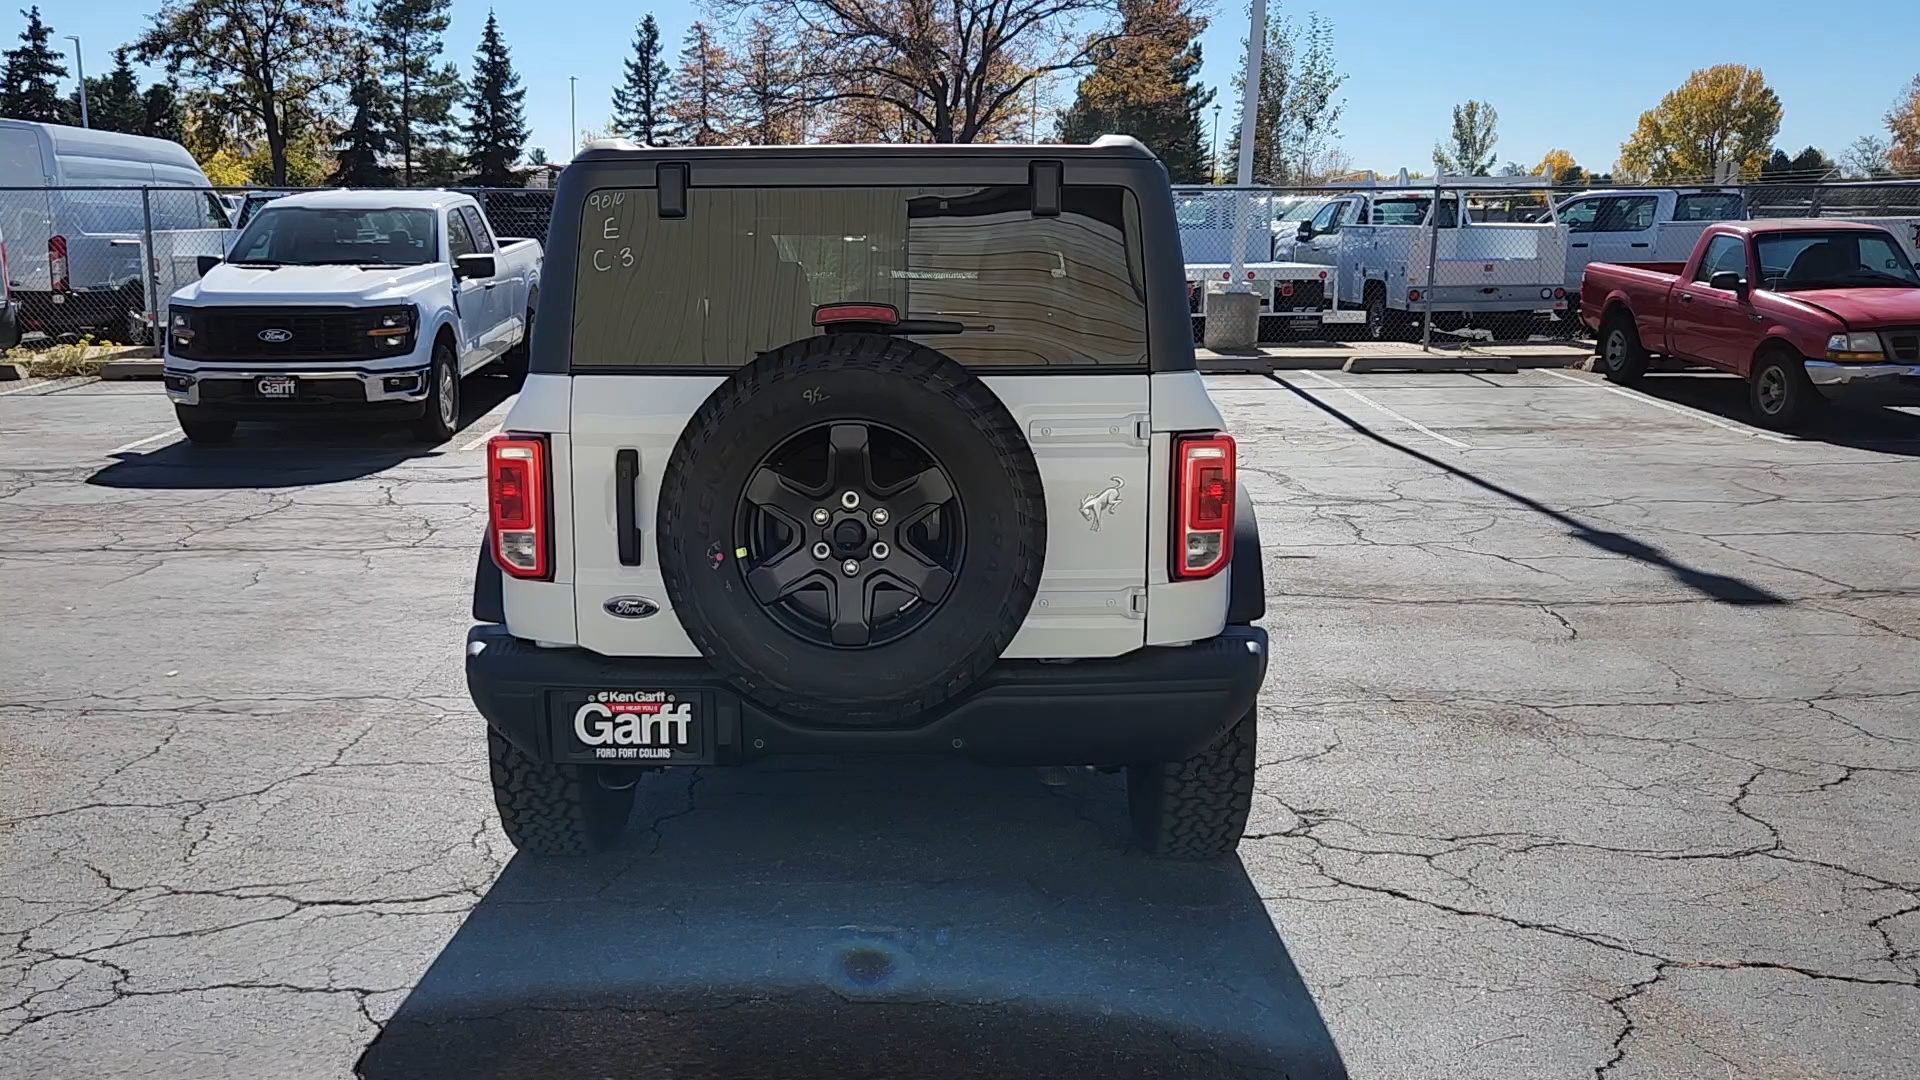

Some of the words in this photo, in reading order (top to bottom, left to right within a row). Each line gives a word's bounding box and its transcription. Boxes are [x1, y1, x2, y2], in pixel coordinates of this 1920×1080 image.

[603, 217, 620, 239] E
[258, 380, 296, 394] Garff
[609, 691, 634, 702] Ken
[635, 691, 666, 702] Garff
[574, 703, 692, 745] Garff
[596, 748, 617, 758] FORD
[618, 748, 638, 758] FORT
[639, 748, 671, 758] COLLINS
